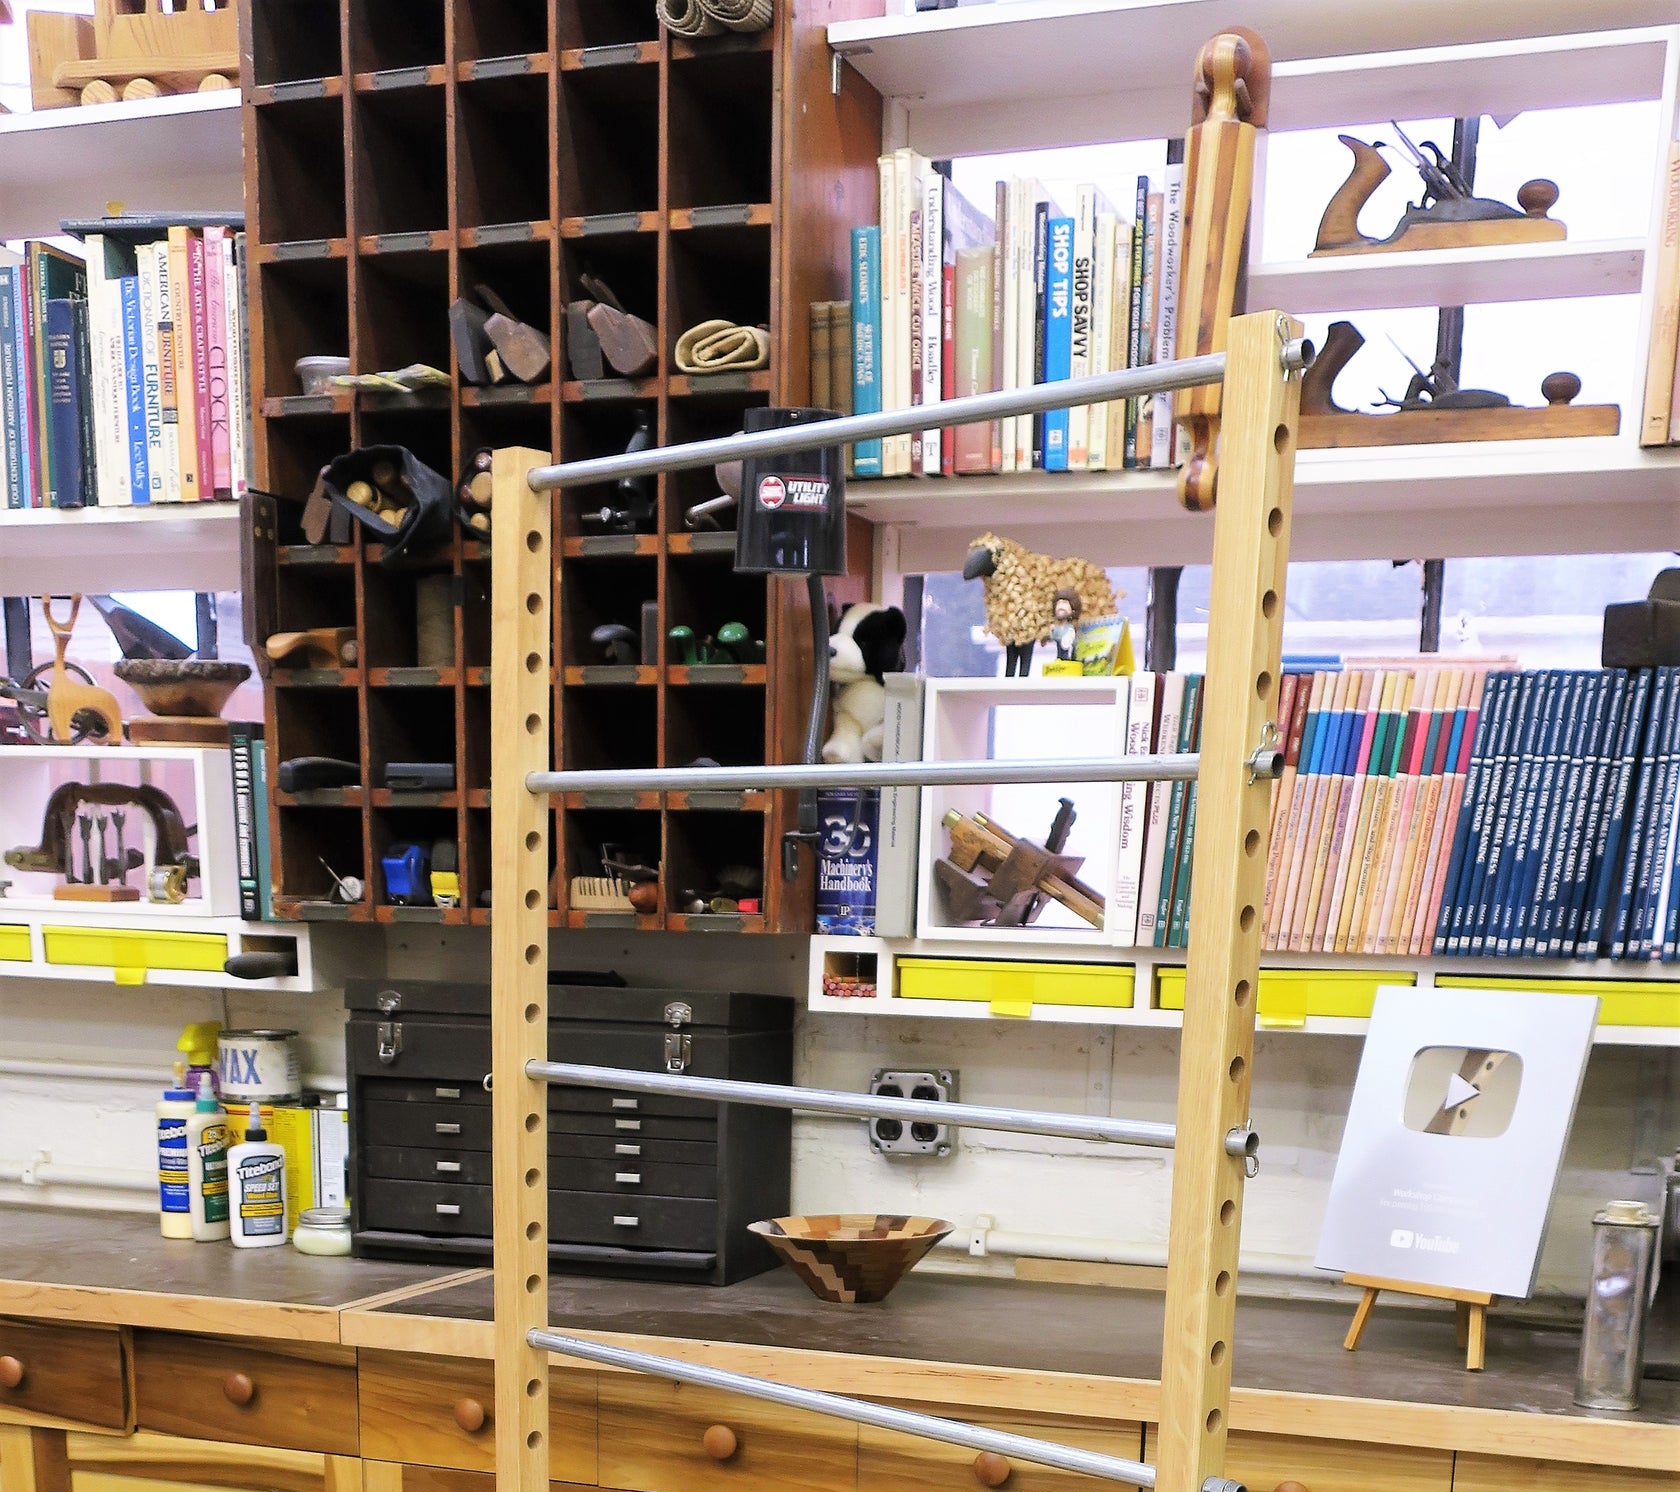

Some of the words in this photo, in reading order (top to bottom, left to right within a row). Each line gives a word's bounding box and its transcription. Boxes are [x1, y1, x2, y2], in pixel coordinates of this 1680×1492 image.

[1170, 181, 1181, 204] The
[926, 188, 939, 278] Understanding
[911, 223, 921, 273] MEASURE
[1053, 224, 1070, 274] SHOP
[1164, 210, 1180, 300] Woodworker's
[125, 280, 136, 296] The
[157, 252, 171, 320] AMERICAN
[1075, 258, 1090, 302] SHOP
[141, 272, 154, 336] DICTIONARY
[174, 282, 182, 322] COUNTRY
[194, 292, 203, 314] ARTS
[928, 281, 939, 316] Wood
[1052, 279, 1069, 319] TIPS
[1133, 287, 1141, 305] FOR
[125, 297, 137, 345] Victorian
[195, 315, 203, 324] &
[911, 315, 921, 336] CUT
[1074, 305, 1088, 358] SAVVY
[1162, 307, 1175, 359] Problem
[145, 340, 156, 357] OF
[177, 324, 185, 369] FURNITURE
[196, 325, 205, 364] CRAFTS
[912, 340, 921, 370] ONCE
[5, 343, 13, 385] FURNITURE
[127, 346, 139, 383] Design
[927, 336, 938, 384] Hoadley
[198, 365, 206, 394] STYLE
[209, 346, 227, 438] CLOCK
[7, 387, 15, 426] AMERICAN
[131, 384, 142, 413] Book
[145, 363, 161, 448] FURNITURE
[9, 429, 16, 439] OF
[9, 440, 18, 481] CENTURIES
[133, 441, 143, 459] Lee
[134, 459, 145, 490] Valley
[788, 481, 829, 494] UTILITY
[793, 494, 825, 505] LIGHT
[1141, 722, 1150, 742] Nick
[234, 746, 249, 793] VISUAL
[1491, 763, 1503, 802] SANDING
[1505, 765, 1517, 795] USING
[1520, 762, 1530, 789] USING
[1530, 764, 1542, 788] USING
[1543, 763, 1554, 788] USING
[1558, 764, 1568, 785] WOOD
[1568, 767, 1580, 800] MAKING
[1581, 764, 1593, 798] MAKING
[1594, 766, 1607, 801] MAKING
[1608, 768, 1619, 794] USING
[1654, 764, 1666, 803] COMPLETE
[1666, 763, 1679, 802] MAKING
[1464, 766, 1478, 807] FINISHING
[1479, 768, 1492, 802] JOINING
[1527, 791, 1535, 808] THE
[1540, 791, 1549, 806] THE
[1554, 786, 1563, 803] AND
[1613, 764, 1631, 820] SHARPENING
[1637, 766, 1651, 822] WORKBENCHES
[890, 795, 898, 827] Engineering
[1473, 804, 1484, 832] WOOD
[1486, 804, 1495, 824] AND
[1500, 797, 1510, 815] THE
[1513, 791, 1525, 817] HAND
[1562, 802, 1574, 829] DESKS
[1575, 800, 1586, 827] BOXES
[1605, 796, 1613, 811] THE
[1650, 804, 1660, 828] INDEX
[1662, 804, 1673, 825] JIGS
[239, 824, 249, 837] AND
[1121, 804, 1134, 849] Wisdom
[1273, 810, 1286, 851] Woodworking
[1495, 817, 1507, 844] DRILL
[1507, 818, 1519, 847] TOOLS
[1521, 810, 1532, 842] SCROLL
[1537, 808, 1547, 829] BAND
[1544, 805, 1560, 861] WOODWORKING
[1586, 803, 1600, 839] BUILT-IN
[1600, 814, 1610, 837] TABLE
[823, 815, 872, 857] 30
[1476, 824, 1492, 864] PLANING
[1533, 832, 1542, 850] SAW
[1559, 830, 1569, 849] AND
[1571, 828, 1581, 848] AND
[1596, 839, 1604, 856] SAW
[1632, 832, 1641, 851] SHOP
[1646, 837, 1655, 855] SHOP
[1660, 827, 1669, 848] AND
[820, 858, 873, 876] Machinery's
[1488, 847, 1501, 875] PRESS
[1515, 843, 1526, 862] SAW
[1564, 849, 1577, 883] CHESTS
[1577, 840, 1592, 883] CABINETS
[820, 876, 872, 891] Handbook
[1536, 863, 1549, 901] MATERIALS
[1548, 850, 1566, 902] BOOKCASES
[1624, 853, 1637, 895] FURNITURE
[1640, 857, 1652, 888] MANUAL
[1651, 849, 1665, 895] FIXTURES
[1176, 899, 1184, 916] Engler
[236, 1154, 284, 1180] Titebond
[244, 1183, 267, 1193] SPEED
[267, 1182, 279, 1191] SET
[1415, 1232, 1460, 1254] YouTube
